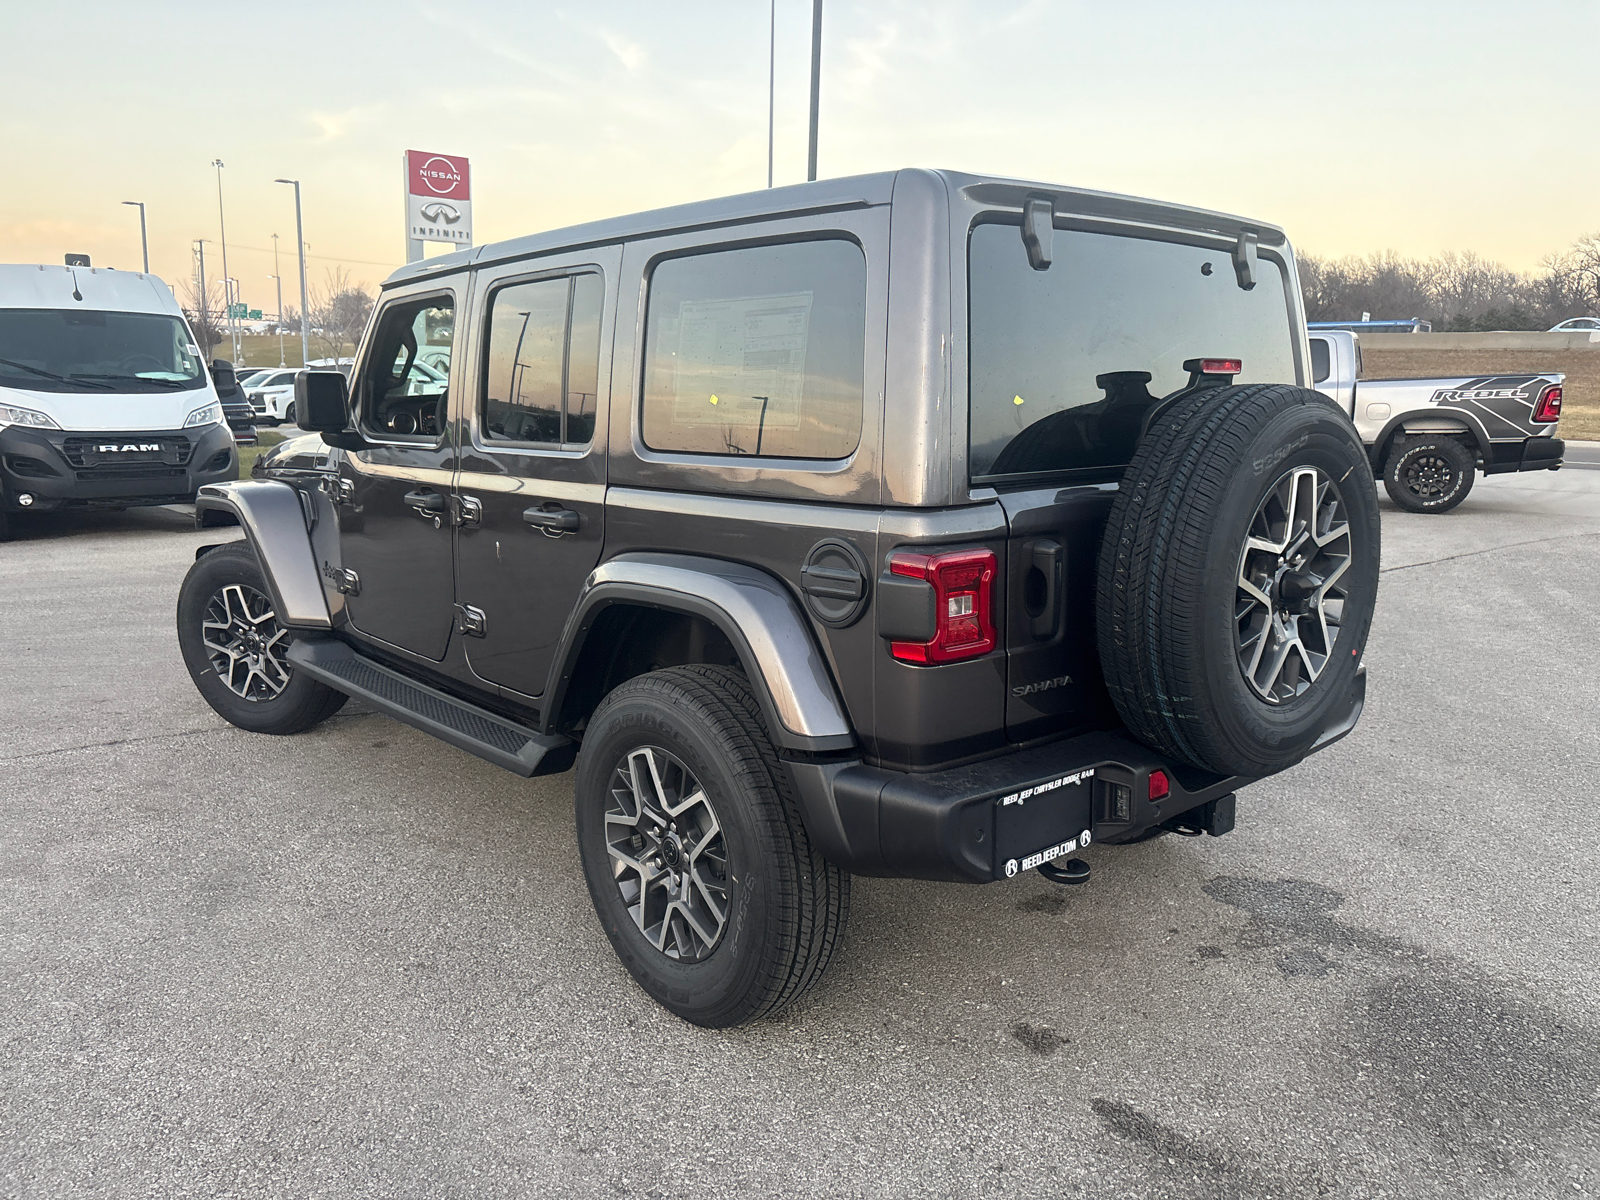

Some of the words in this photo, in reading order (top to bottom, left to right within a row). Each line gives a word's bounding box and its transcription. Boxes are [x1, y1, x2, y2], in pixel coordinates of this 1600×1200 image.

[419, 169, 461, 181] NISSAN
[413, 226, 470, 239] INFINITI
[1429, 388, 1530, 402] REBEL
[98, 444, 160, 452] RAM
[1393, 445, 1436, 483] GOODYEAR
[1011, 675, 1074, 697] SAHARA
[1003, 793, 1018, 806] REED
[1020, 788, 1033, 800] JEEP
[1033, 778, 1062, 796] CHRYSLER
[1062, 772, 1081, 786] DODGE
[1081, 768, 1095, 779] RAM
[1021, 839, 1077, 871] REEDJEEP.COM
